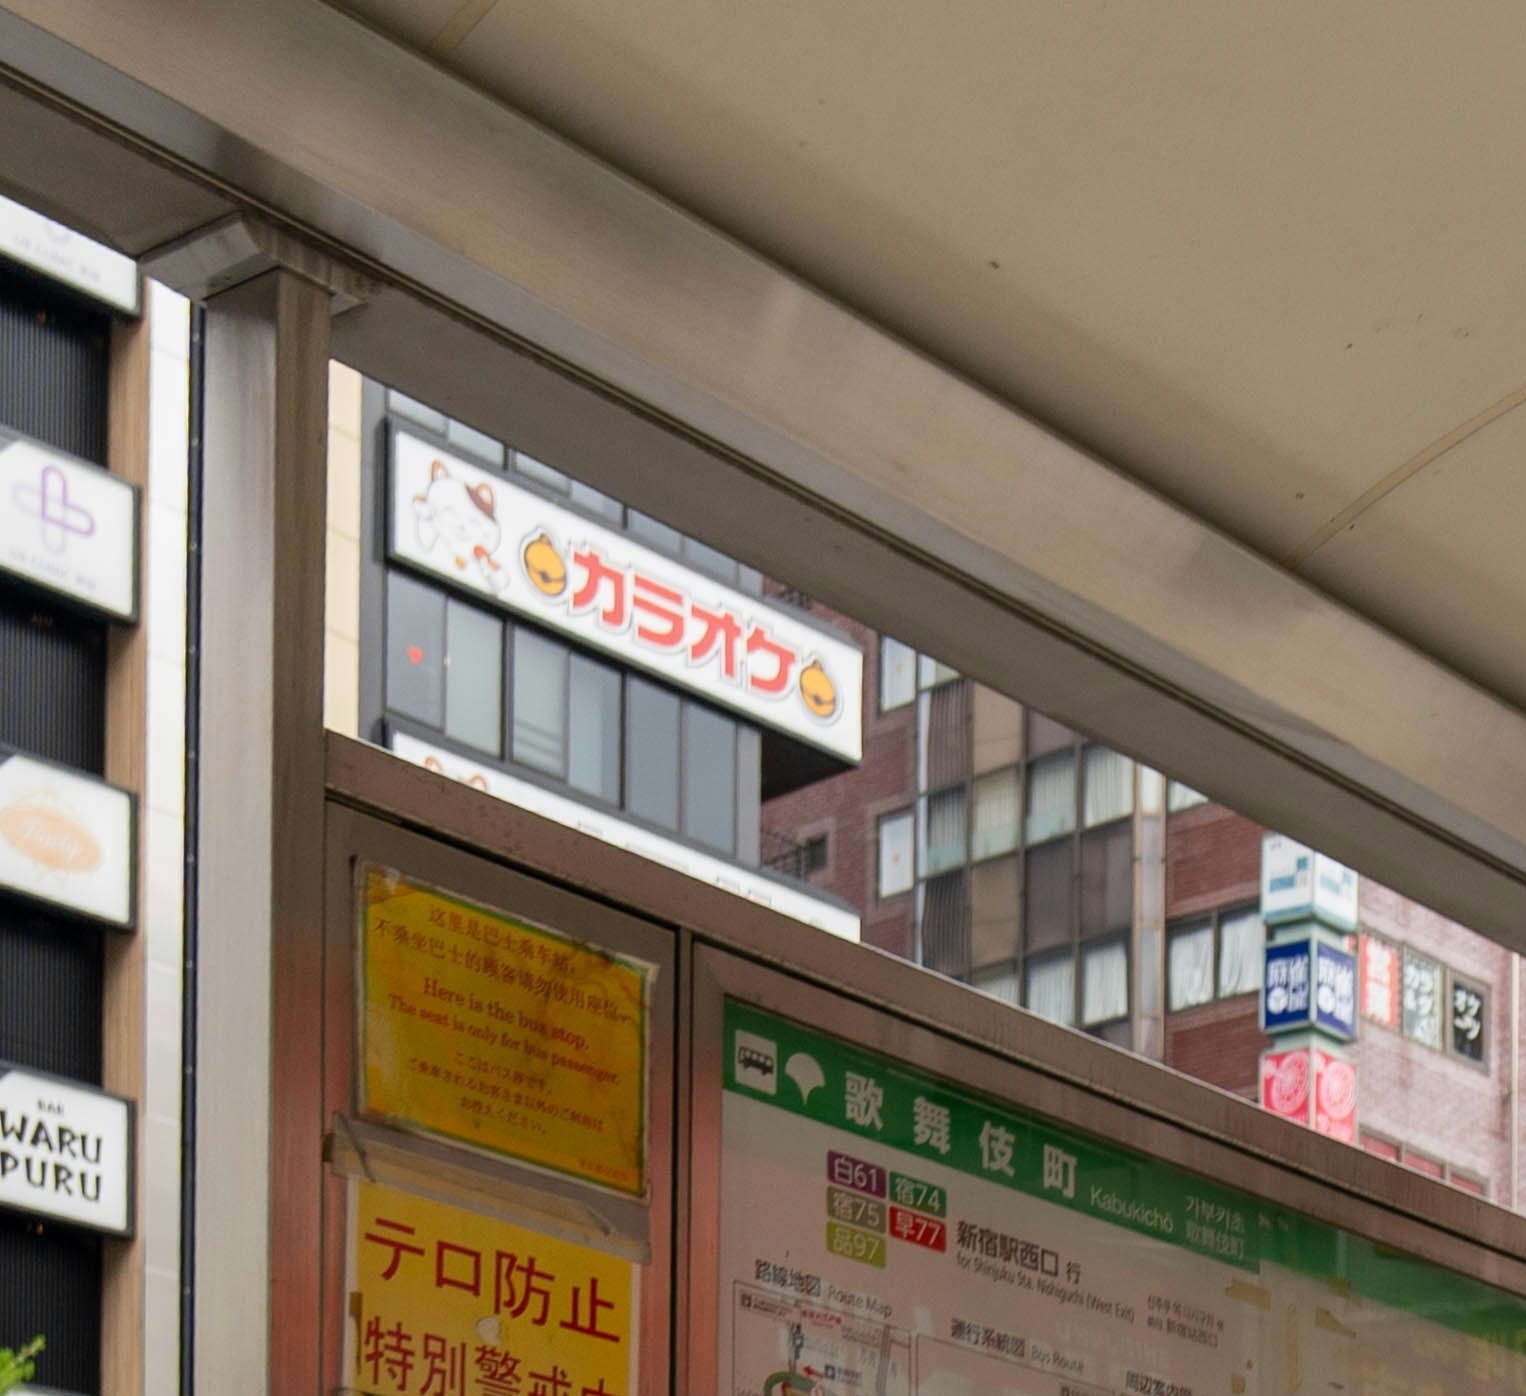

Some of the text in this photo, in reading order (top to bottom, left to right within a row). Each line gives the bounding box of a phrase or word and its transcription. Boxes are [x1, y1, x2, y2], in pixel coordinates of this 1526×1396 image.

[571, 549, 796, 694] カラオケ
[423, 977, 465, 1007] Here
[487, 1001, 515, 1024] the
[843, 1070, 1077, 1199] 歌舞伎町
[832, 1225, 883, 1263] 品97
[893, 1209, 945, 1249] 早77
[957, 1220, 1082, 1285] 新宿駅西口 行
[364, 1217, 622, 1344] テロ防止
